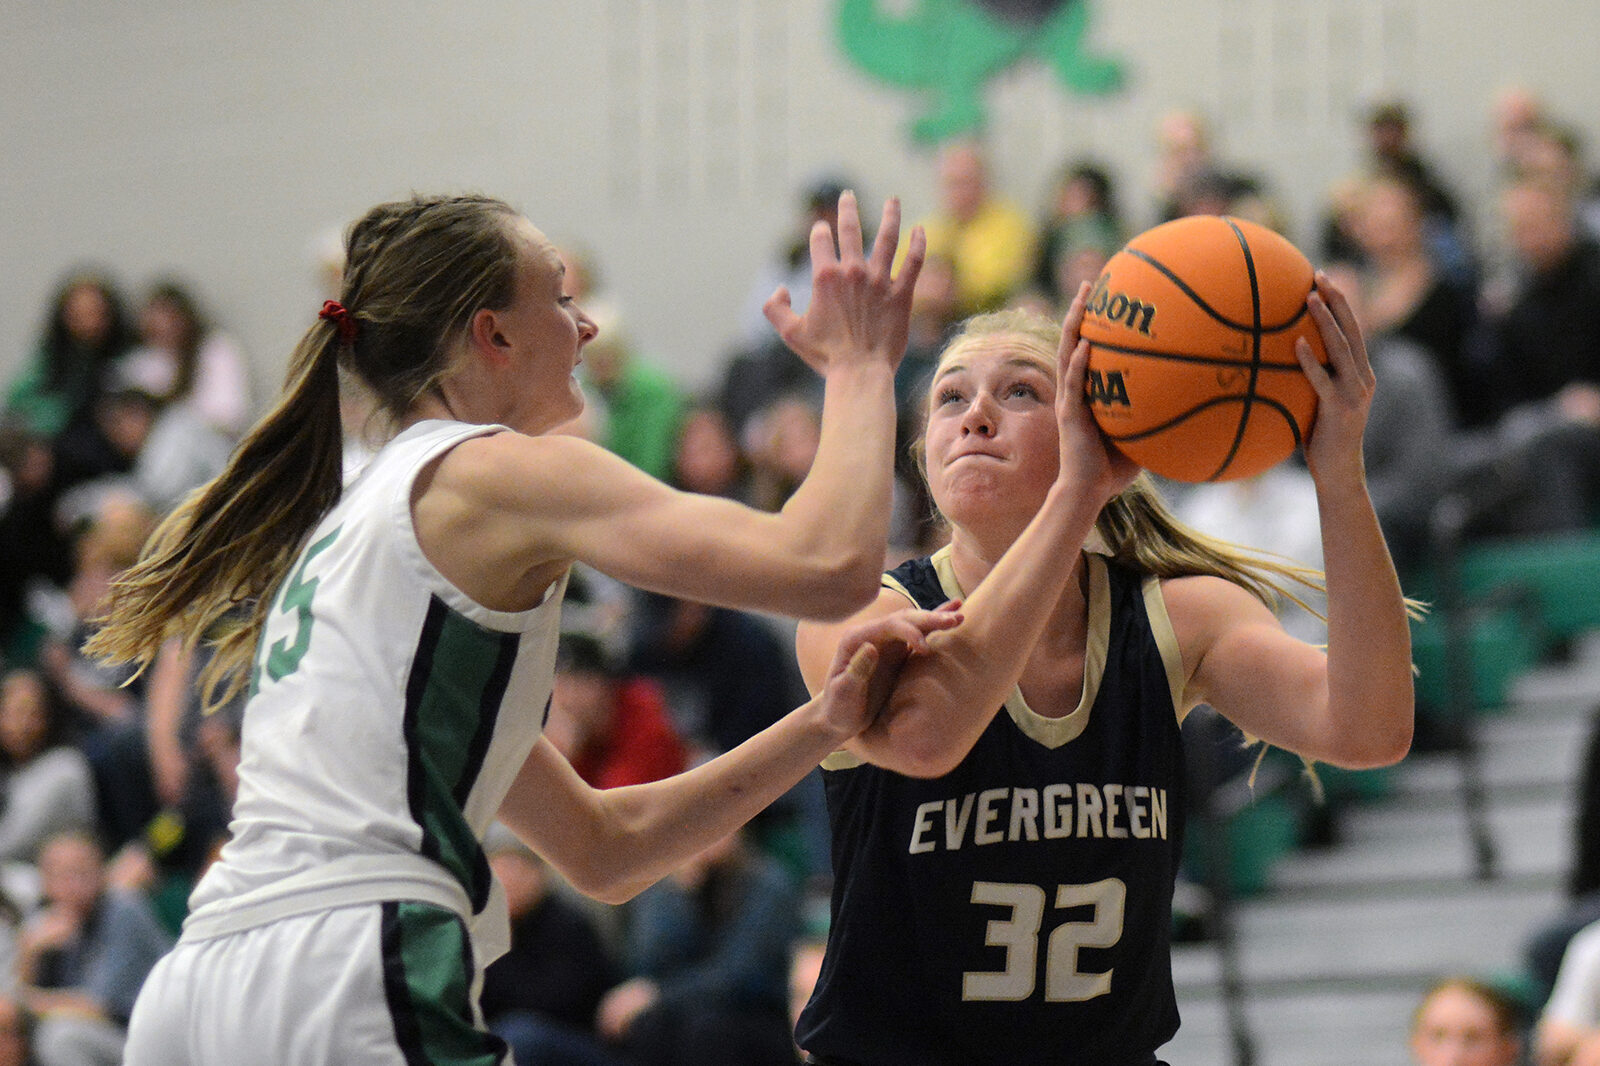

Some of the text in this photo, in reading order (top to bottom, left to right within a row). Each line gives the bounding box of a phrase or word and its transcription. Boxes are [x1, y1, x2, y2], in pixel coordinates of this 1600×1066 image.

[1087, 272, 1155, 335] lson
[1086, 370, 1131, 406] AA
[909, 783, 1167, 854] EVERGREEN
[962, 877, 1127, 1002] 32
